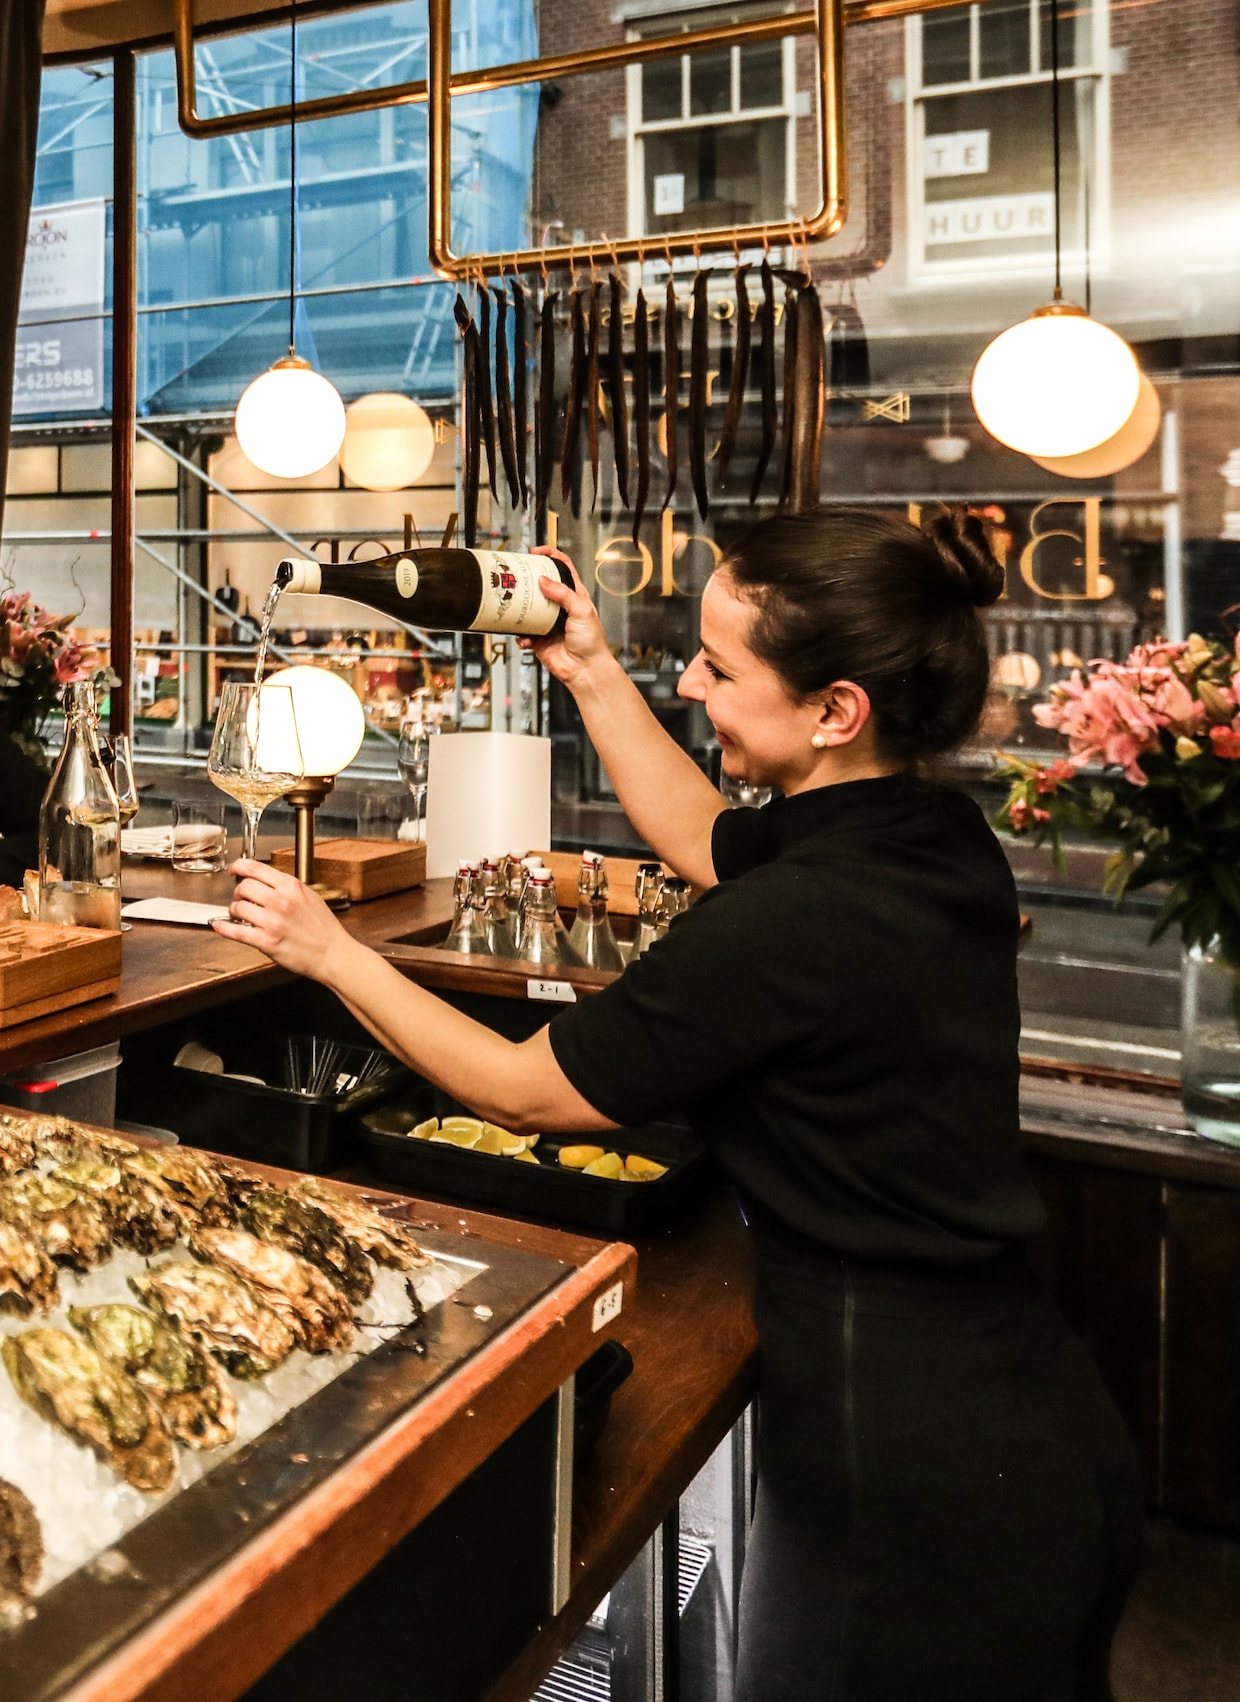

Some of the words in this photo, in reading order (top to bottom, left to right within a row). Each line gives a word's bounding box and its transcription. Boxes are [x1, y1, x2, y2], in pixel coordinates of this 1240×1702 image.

[933, 144, 977, 169] TE
[930, 207, 1046, 236] HUUR
[403, 568, 412, 587] 2019
